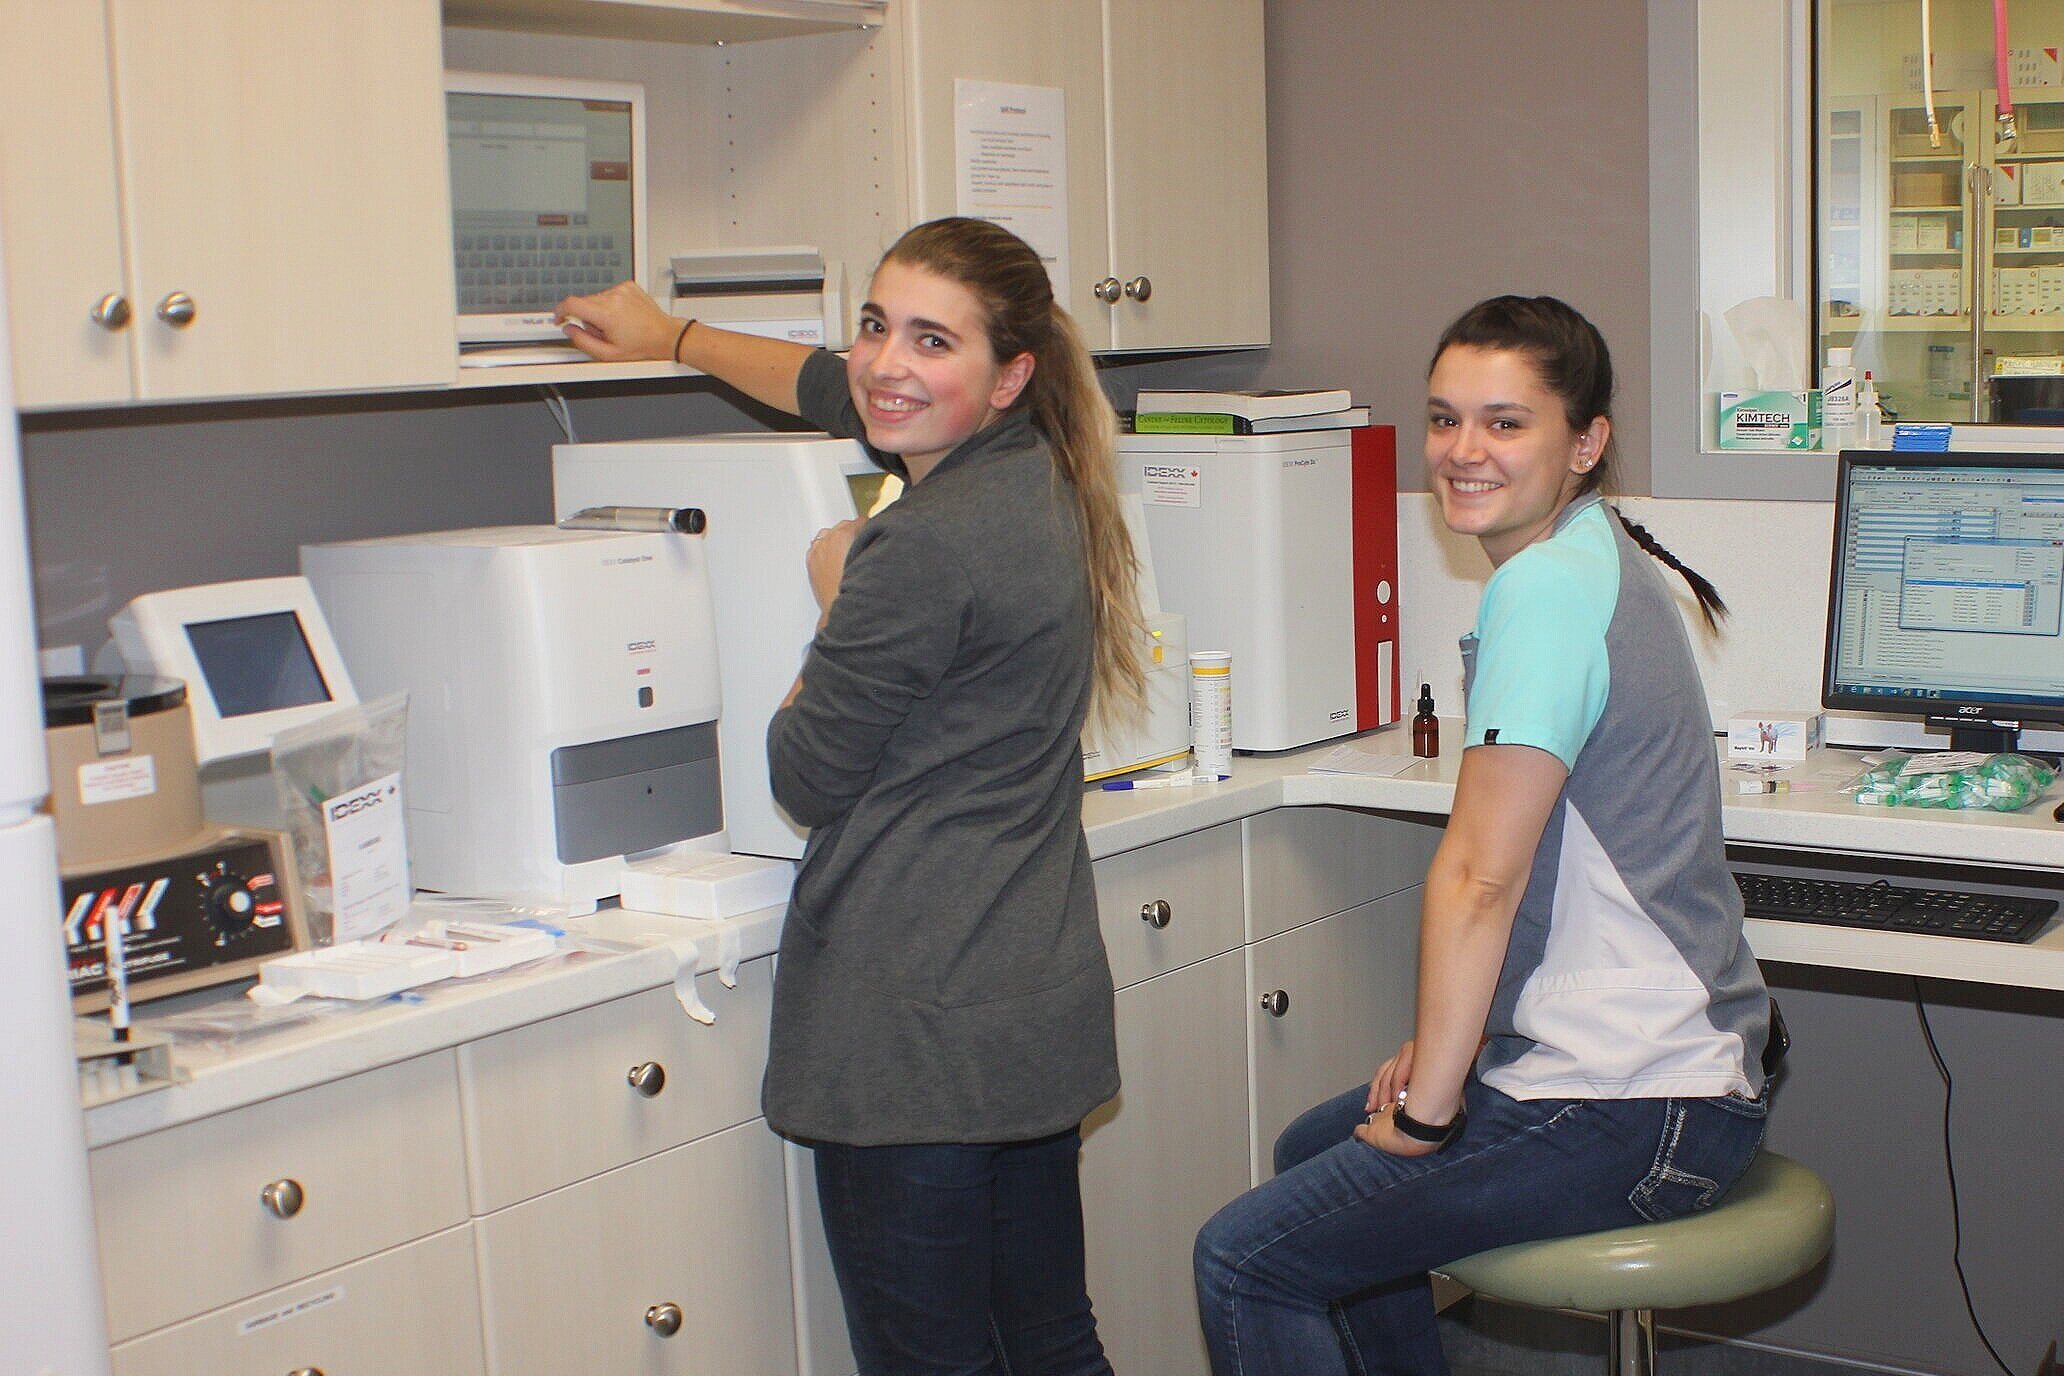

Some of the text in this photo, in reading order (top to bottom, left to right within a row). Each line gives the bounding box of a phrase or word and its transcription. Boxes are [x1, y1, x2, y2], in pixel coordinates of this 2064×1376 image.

[1736, 413, 1790, 422] KIMTECH
[1144, 466, 1186, 479] IDEXX
[1329, 709, 1350, 720] IDEXX
[1958, 706, 1984, 714] acer
[331, 788, 383, 822] IDEXX
